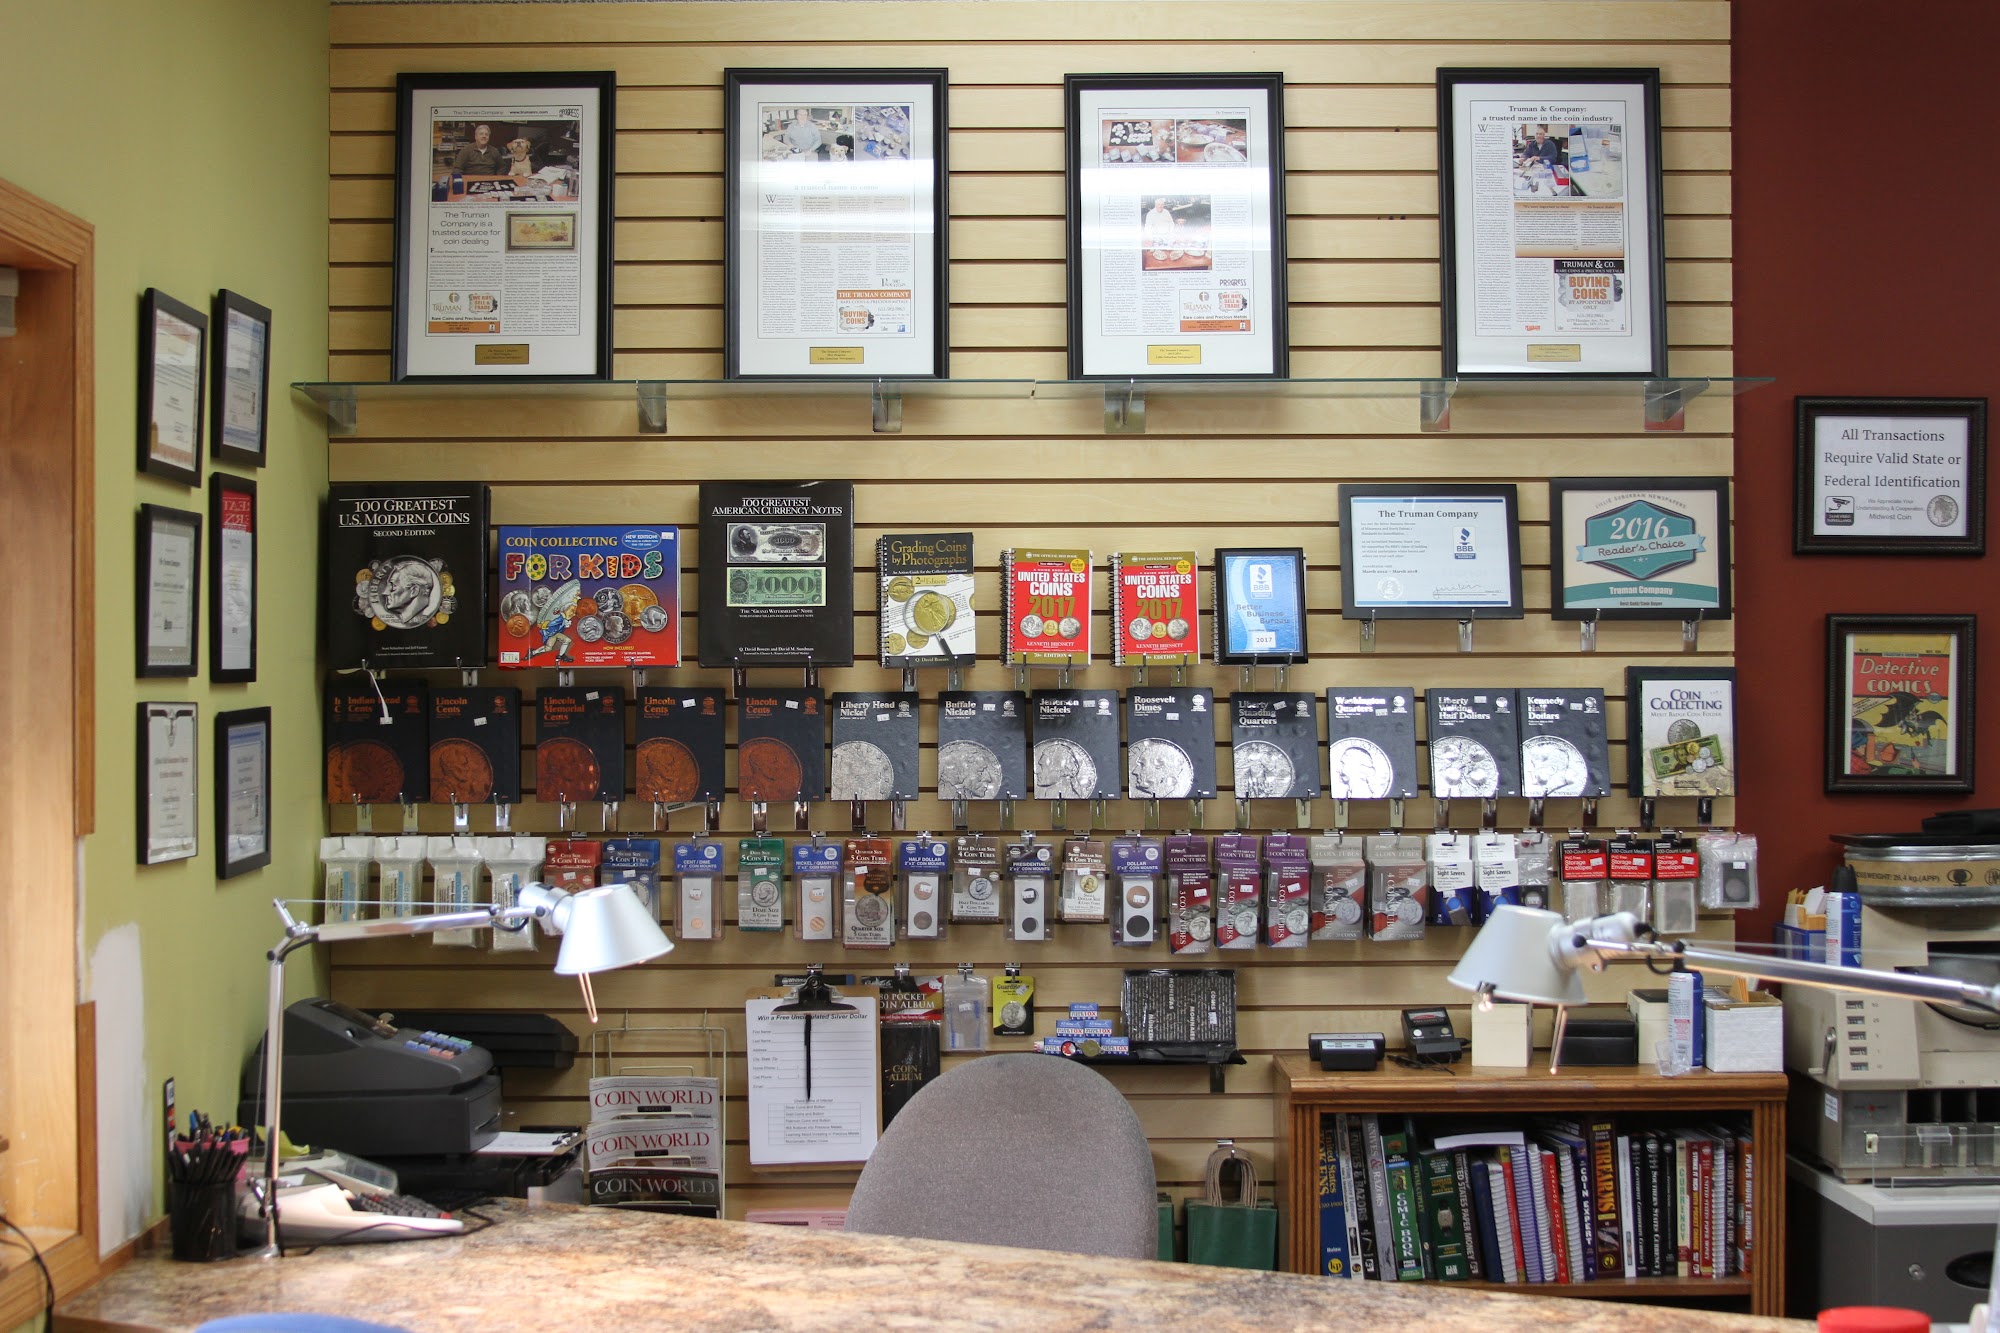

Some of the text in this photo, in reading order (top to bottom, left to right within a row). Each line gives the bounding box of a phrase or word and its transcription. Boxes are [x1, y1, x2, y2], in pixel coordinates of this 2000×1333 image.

[1549, 106, 1587, 114] Company:
[1569, 276, 1610, 288] BUYING
[1573, 288, 1606, 299] COINS
[1841, 430, 1945, 442] All Transactions
[1824, 452, 1961, 466] Require Valid State or
[1824, 476, 1960, 488] Federal Identification
[354, 500, 456, 513] 100 GREATEST
[712, 506, 842, 515] AMERICAN CURRENCY NOTES
[339, 512, 470, 526] U.S. MODERN COINS
[1436, 510, 1479, 520] Company
[1610, 517, 1669, 540] 2016
[506, 536, 618, 547] COIN COLLECTING
[891, 540, 967, 556] Grading Coins
[1598, 539, 1686, 556] Reader's Choice
[505, 551, 663, 580] FOR KIDS
[892, 553, 967, 568] by Photographs
[1018, 572, 1085, 583] UNITED STATES
[1124, 574, 1191, 584] UNITED STATES
[1030, 582, 1073, 596] COINS
[1137, 585, 1179, 598] COINS
[1609, 586, 1673, 595] Truman Company
[1028, 596, 1076, 617] 2017
[1136, 599, 1182, 619] 2017
[1860, 658, 1940, 676] Detective
[1867, 680, 1931, 693] COMICS
[1670, 689, 1701, 700] COIN
[436, 697, 468, 705] Lincoln
[644, 697, 676, 705] Lincoln
[746, 697, 777, 706] Lincoln
[840, 700, 895, 710] Liberty Head
[1238, 701, 1268, 709] Liberty
[1335, 697, 1386, 705] Washington
[1438, 697, 1468, 705] Liberty
[1527, 697, 1564, 706] Kennedy
[1650, 698, 1722, 710] COLLECTING
[436, 705, 460, 713] Cents
[644, 705, 668, 714] Cents
[945, 708, 976, 716] Nickels
[1238, 709, 1276, 717] Standing
[1335, 705, 1373, 713] Quarters
[1239, 717, 1277, 725] Quarters
[1528, 712, 1560, 720] Dollars
[595, 1090, 712, 1108] COIN WORLD
[592, 1132, 709, 1155] COIN WORLD
[1368, 1122, 1384, 1207] KNIVES & RAZORS
[595, 1178, 714, 1195] COIN WORLD
[1580, 1169, 1592, 1245] COIN EXPERT
[1397, 1193, 1414, 1256] COMIC BOOK
